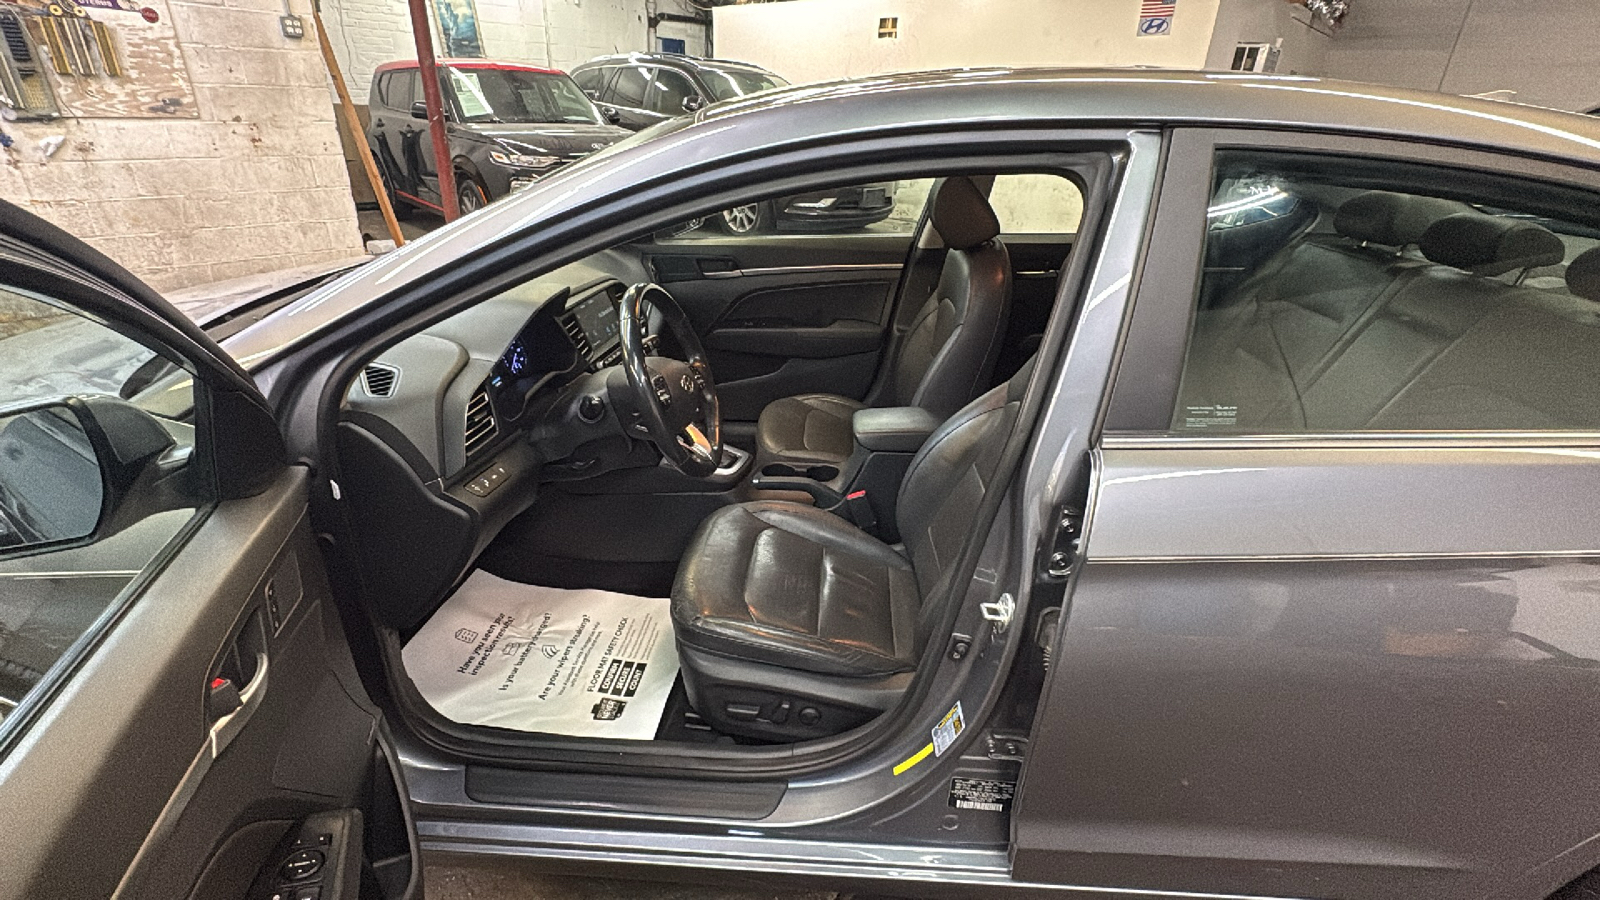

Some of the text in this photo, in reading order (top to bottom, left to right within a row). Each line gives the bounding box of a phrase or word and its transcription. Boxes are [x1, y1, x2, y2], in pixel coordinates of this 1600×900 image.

[457, 655, 475, 674] Have
[473, 641, 485, 656] you
[481, 624, 497, 642] seen
[468, 639, 499, 676] inspection
[498, 683, 509, 691] Is
[506, 667, 519, 683] your
[513, 641, 536, 666] battery
[586, 668, 602, 692] FLOOR
[598, 656, 609, 673] MAT
[604, 637, 619, 656] SAFETY
[538, 685, 551, 701] Are
[547, 669, 560, 686] your
[557, 645, 573, 670] wipers
[601, 662, 620, 689] CONFIRM
[616, 667, 631, 690] SECURE
[629, 669, 642, 691] COUNT
